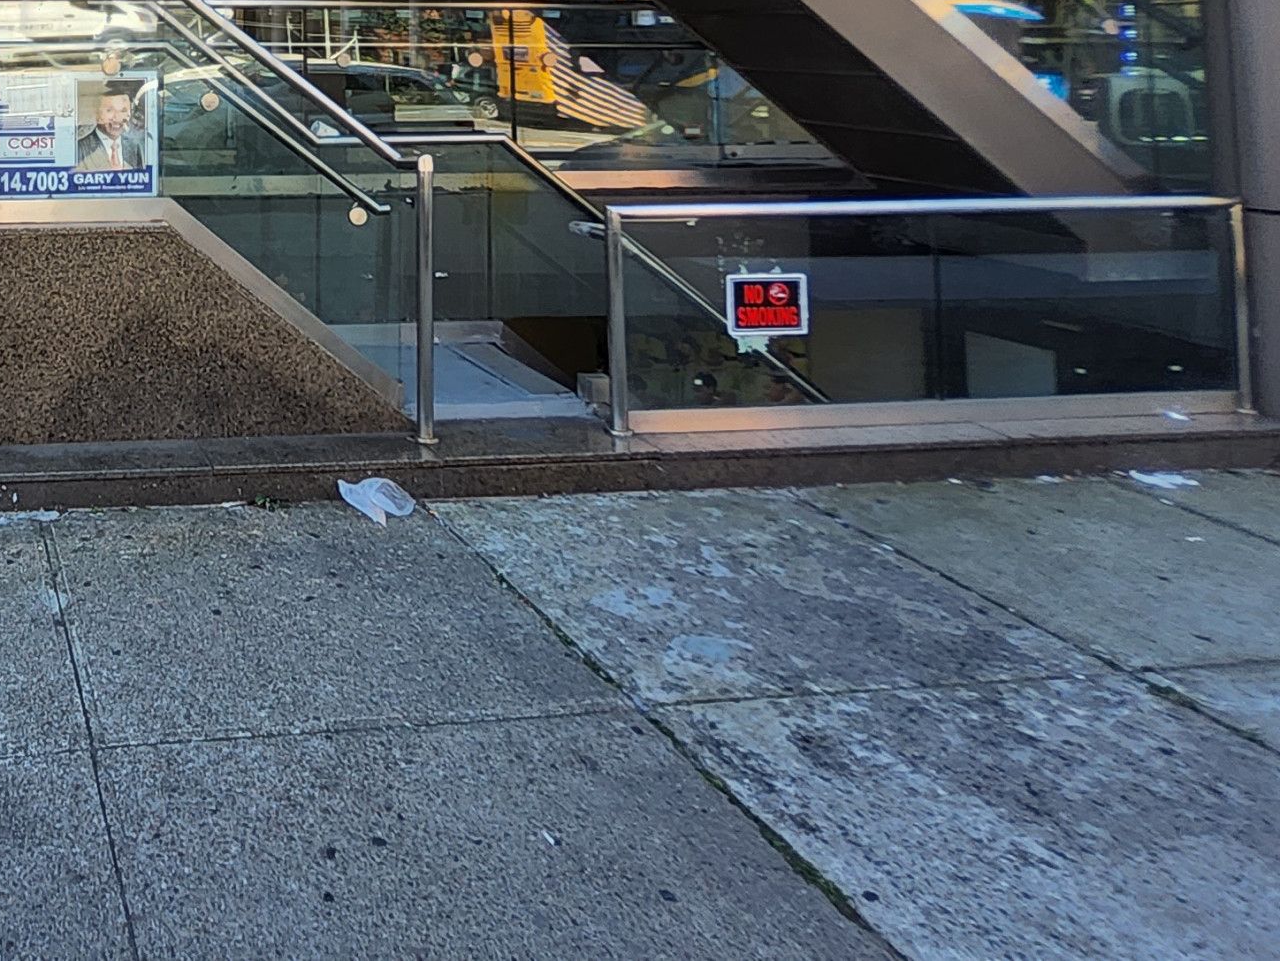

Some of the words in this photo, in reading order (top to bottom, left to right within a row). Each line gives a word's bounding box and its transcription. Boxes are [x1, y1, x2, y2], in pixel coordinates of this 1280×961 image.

[8, 137, 55, 150] COAST
[73, 173, 114, 184] GARY
[117, 172, 150, 184] YUN
[743, 284, 764, 305] NO
[737, 306, 799, 327] SMOKING
